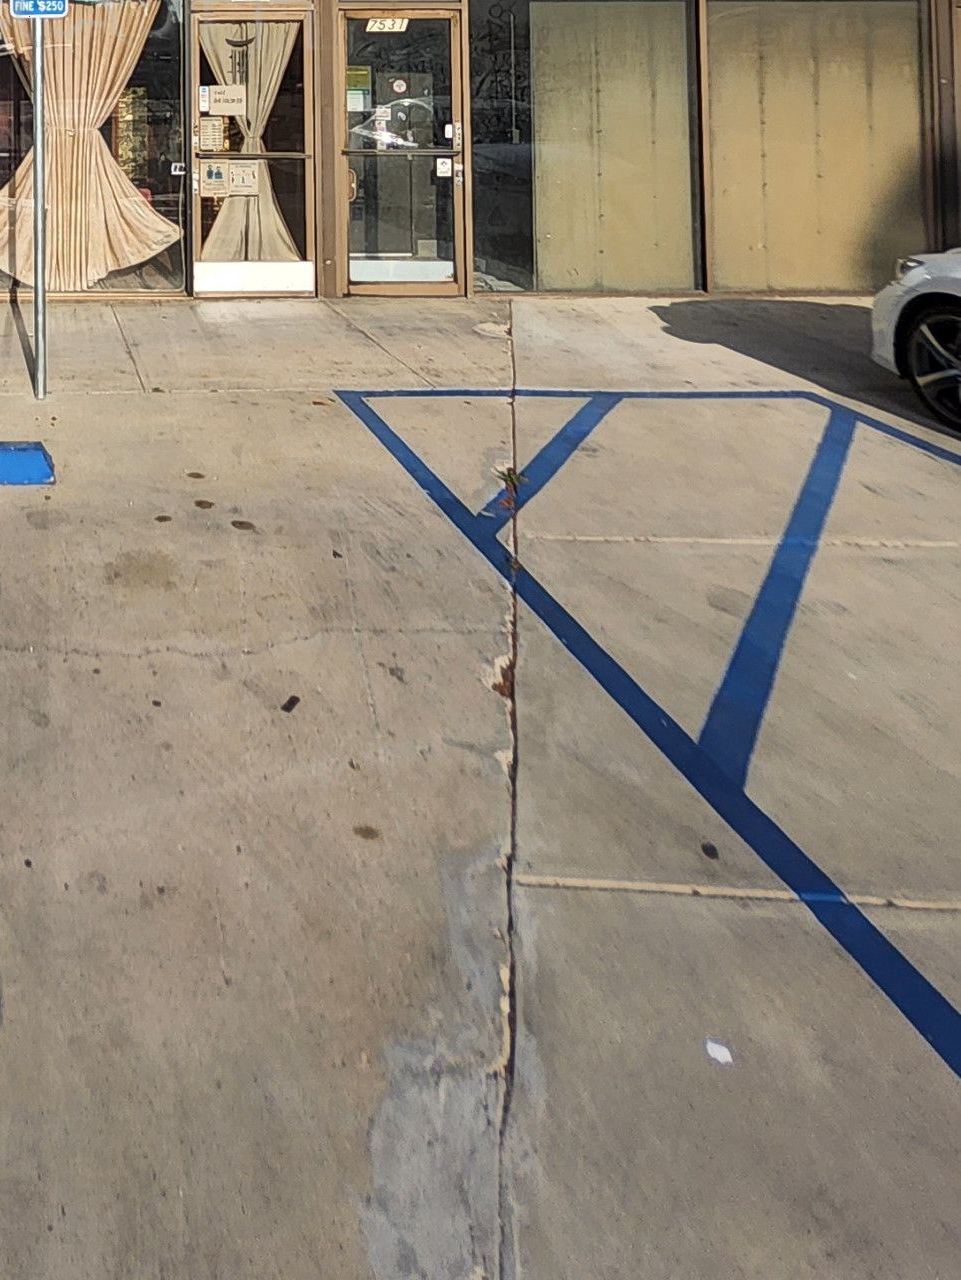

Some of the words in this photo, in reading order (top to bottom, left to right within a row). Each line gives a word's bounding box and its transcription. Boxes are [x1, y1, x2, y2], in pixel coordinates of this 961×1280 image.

[15, 0, 34, 11] FINE
[37, 0, 63, 12] $250
[369, 18, 404, 30] 7531
